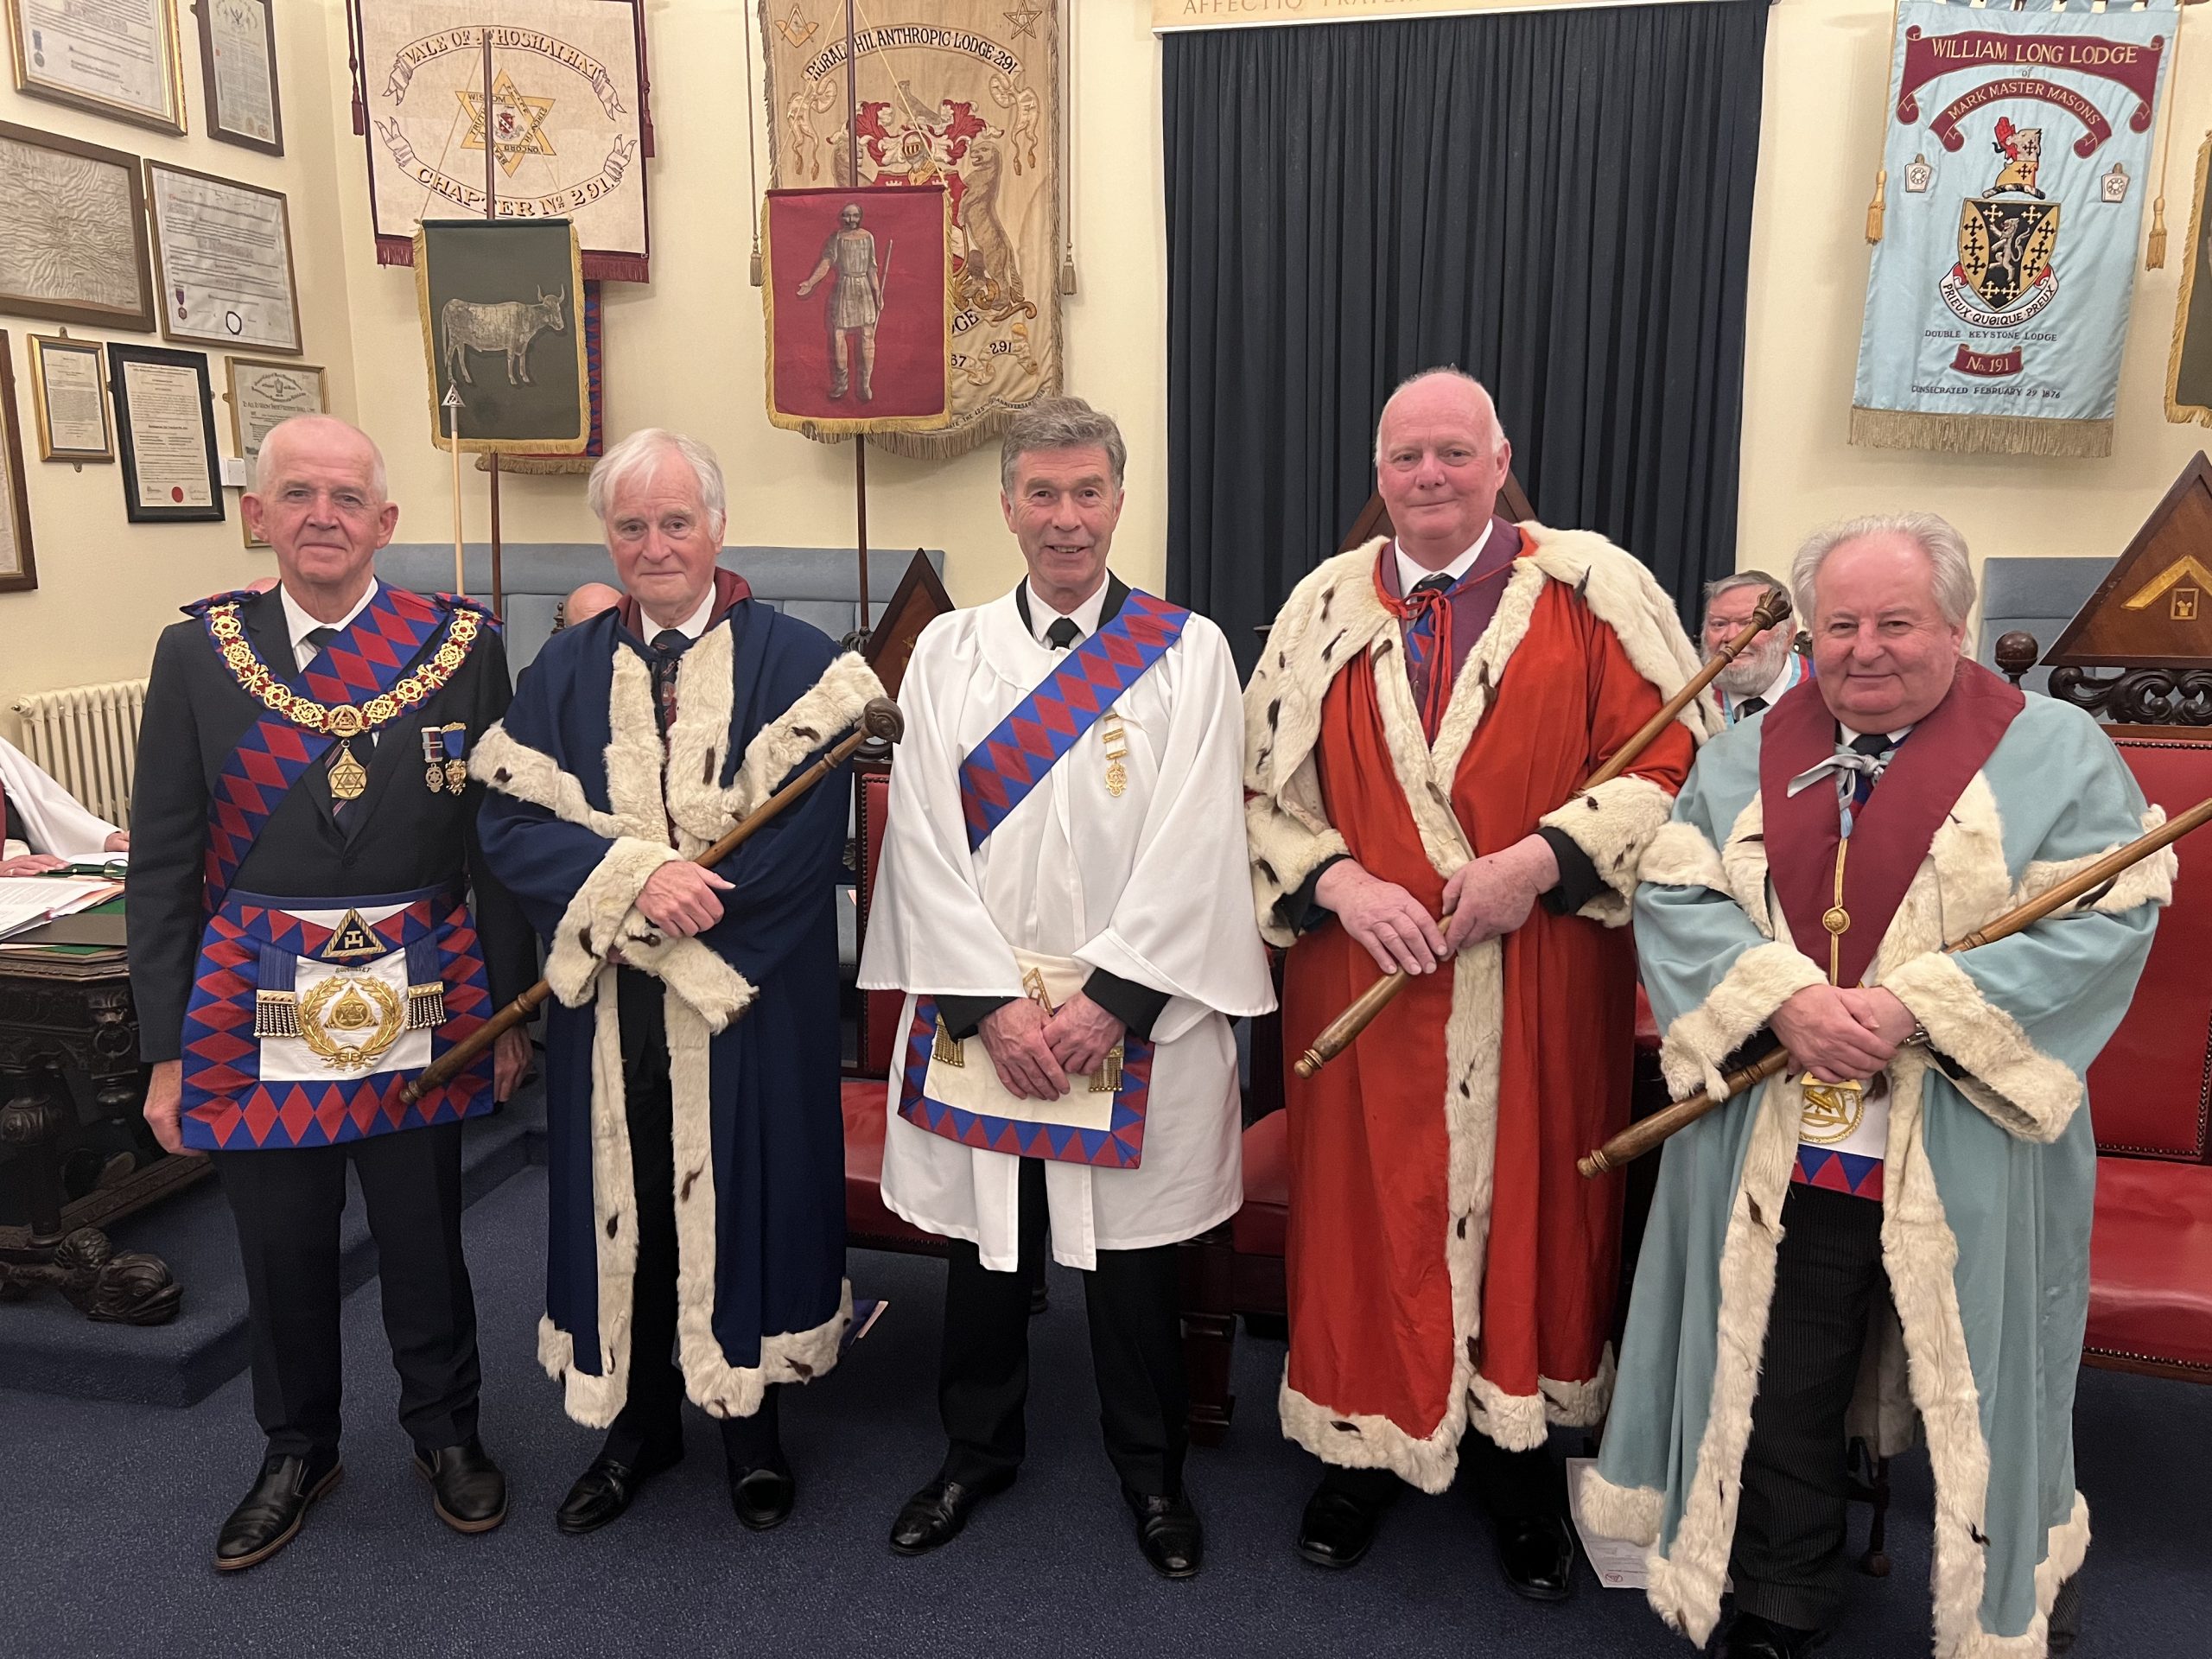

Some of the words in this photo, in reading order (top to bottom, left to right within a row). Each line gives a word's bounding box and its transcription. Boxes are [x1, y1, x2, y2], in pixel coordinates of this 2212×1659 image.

[402, 35, 448, 65] VALE
[451, 29, 471, 48] OF
[806, 46, 849, 82] RURAL
[850, 27, 951, 54] HILANTHROPIC
[953, 32, 995, 60] LODGE
[993, 50, 1019, 76] 291
[1932, 38, 2008, 61] WILLIAM
[2014, 43, 2064, 64] LONG
[2069, 45, 2139, 65] LODGE
[467, 93, 506, 104] WISOM
[1947, 89, 1988, 120] MARK
[1988, 82, 2045, 99] MASTER
[2046, 86, 2101, 125] MASONS
[2026, 284, 2056, 317] PREUX
[1924, 330, 1961, 339] DOUBLE
[1968, 331, 2020, 340] KEYSTONE
[2024, 332, 2057, 342] LODGE
[989, 340, 1012, 354] 291
[1989, 358, 2010, 372] 191
[1911, 385, 1968, 394] CONSECRATED
[1974, 387, 2022, 396] FEBRUARY
[2042, 389, 2061, 398] 1876
